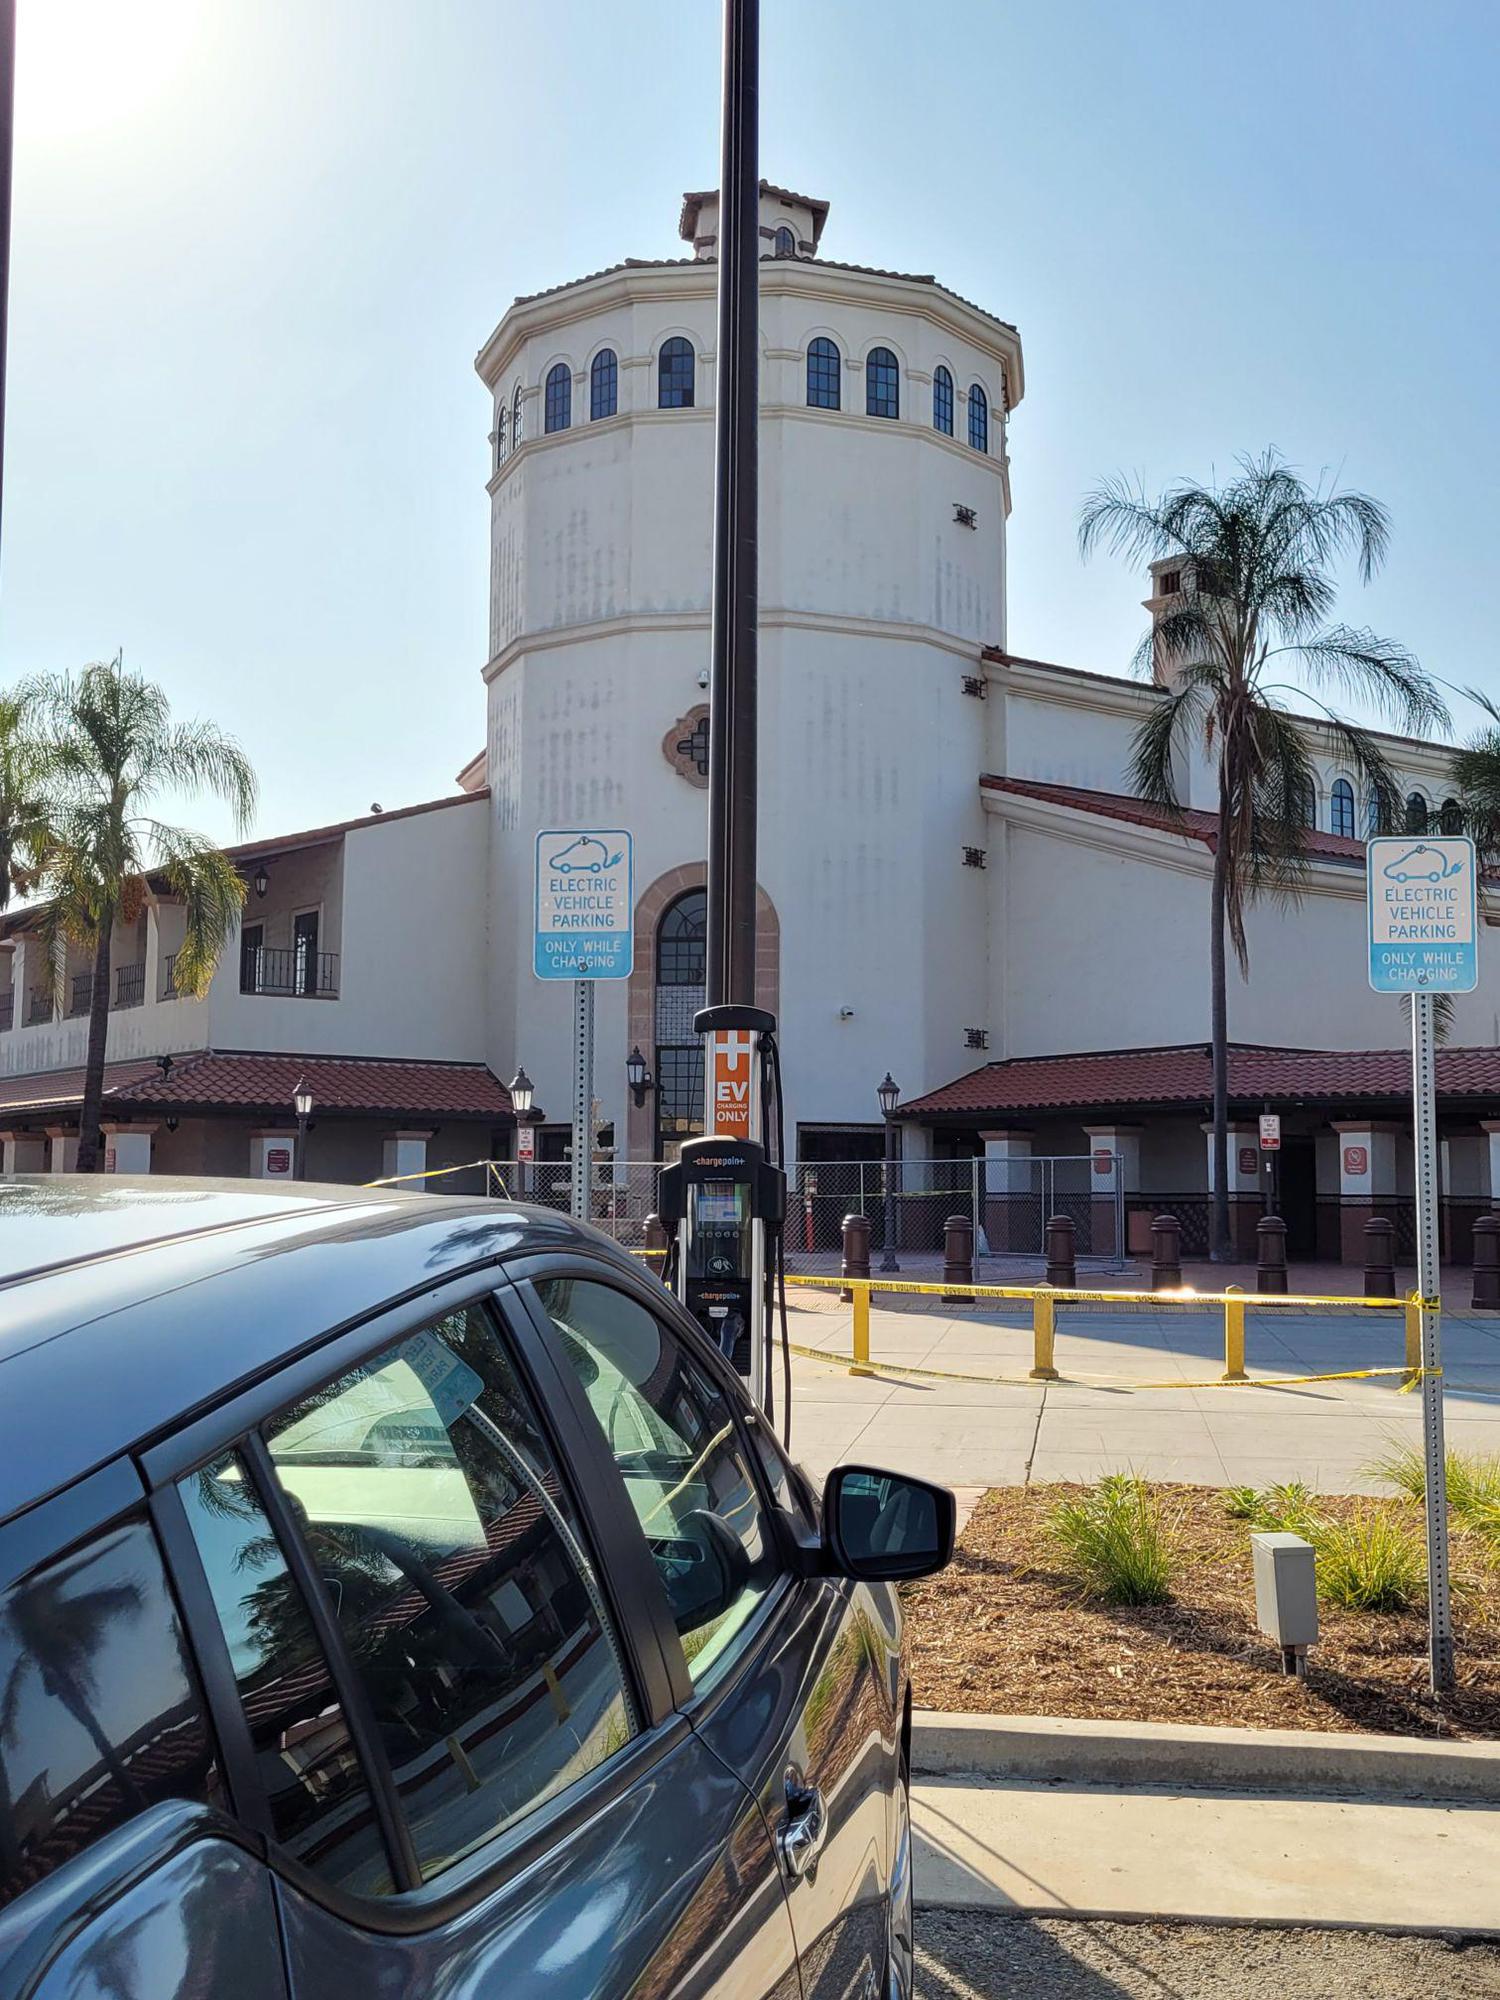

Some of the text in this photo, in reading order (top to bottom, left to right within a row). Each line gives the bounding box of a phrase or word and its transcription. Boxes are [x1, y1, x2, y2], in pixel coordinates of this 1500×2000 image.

[550, 879, 617, 892] ELECTRIC
[1386, 888, 1458, 902] ELECTRIC
[554, 896, 613, 909] VEHICLE
[1390, 907, 1455, 920] VEHICLE
[552, 914, 614, 927] PARKING
[1389, 925, 1456, 938] PARKING
[545, 941, 622, 952] ONLY WHILE
[552, 956, 614, 968] CHARGING
[1382, 952, 1464, 964] ONLY WHILE
[1389, 968, 1458, 980] CHARGING
[717, 1081, 747, 1101] EV
[717, 1111, 748, 1122] ONLY
